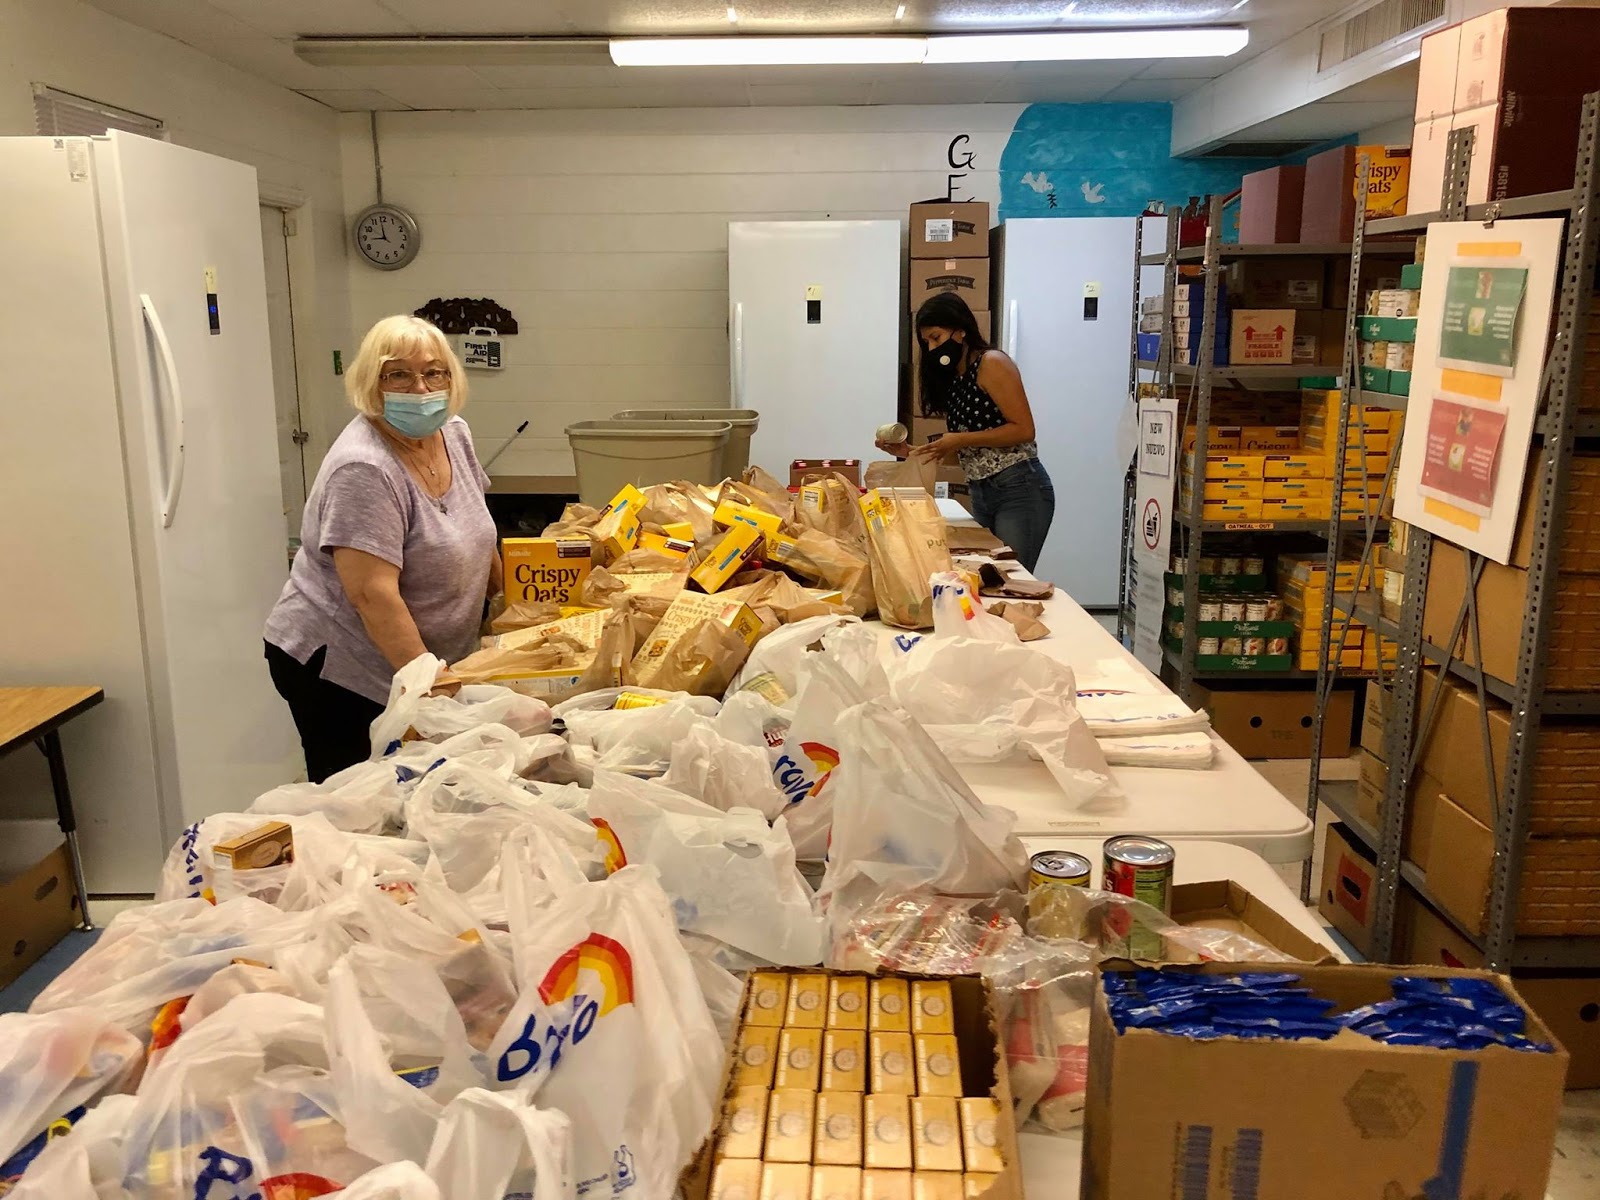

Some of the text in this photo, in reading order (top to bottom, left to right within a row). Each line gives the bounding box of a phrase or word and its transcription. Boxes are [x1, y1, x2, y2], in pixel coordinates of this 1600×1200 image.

[1356, 180, 1392, 194] ats
[364, 225, 373, 233] 10
[398, 225, 404, 233] 2
[362, 234, 368, 242] 9
[402, 234, 408, 242] 3
[366, 243, 372, 251] 8
[393, 250, 399, 258] 5
[1150, 422, 1163, 434] NEW
[1145, 443, 1166, 456] NUEVO
[515, 563, 581, 588] Crispy
[522, 585, 569, 603] Oats
